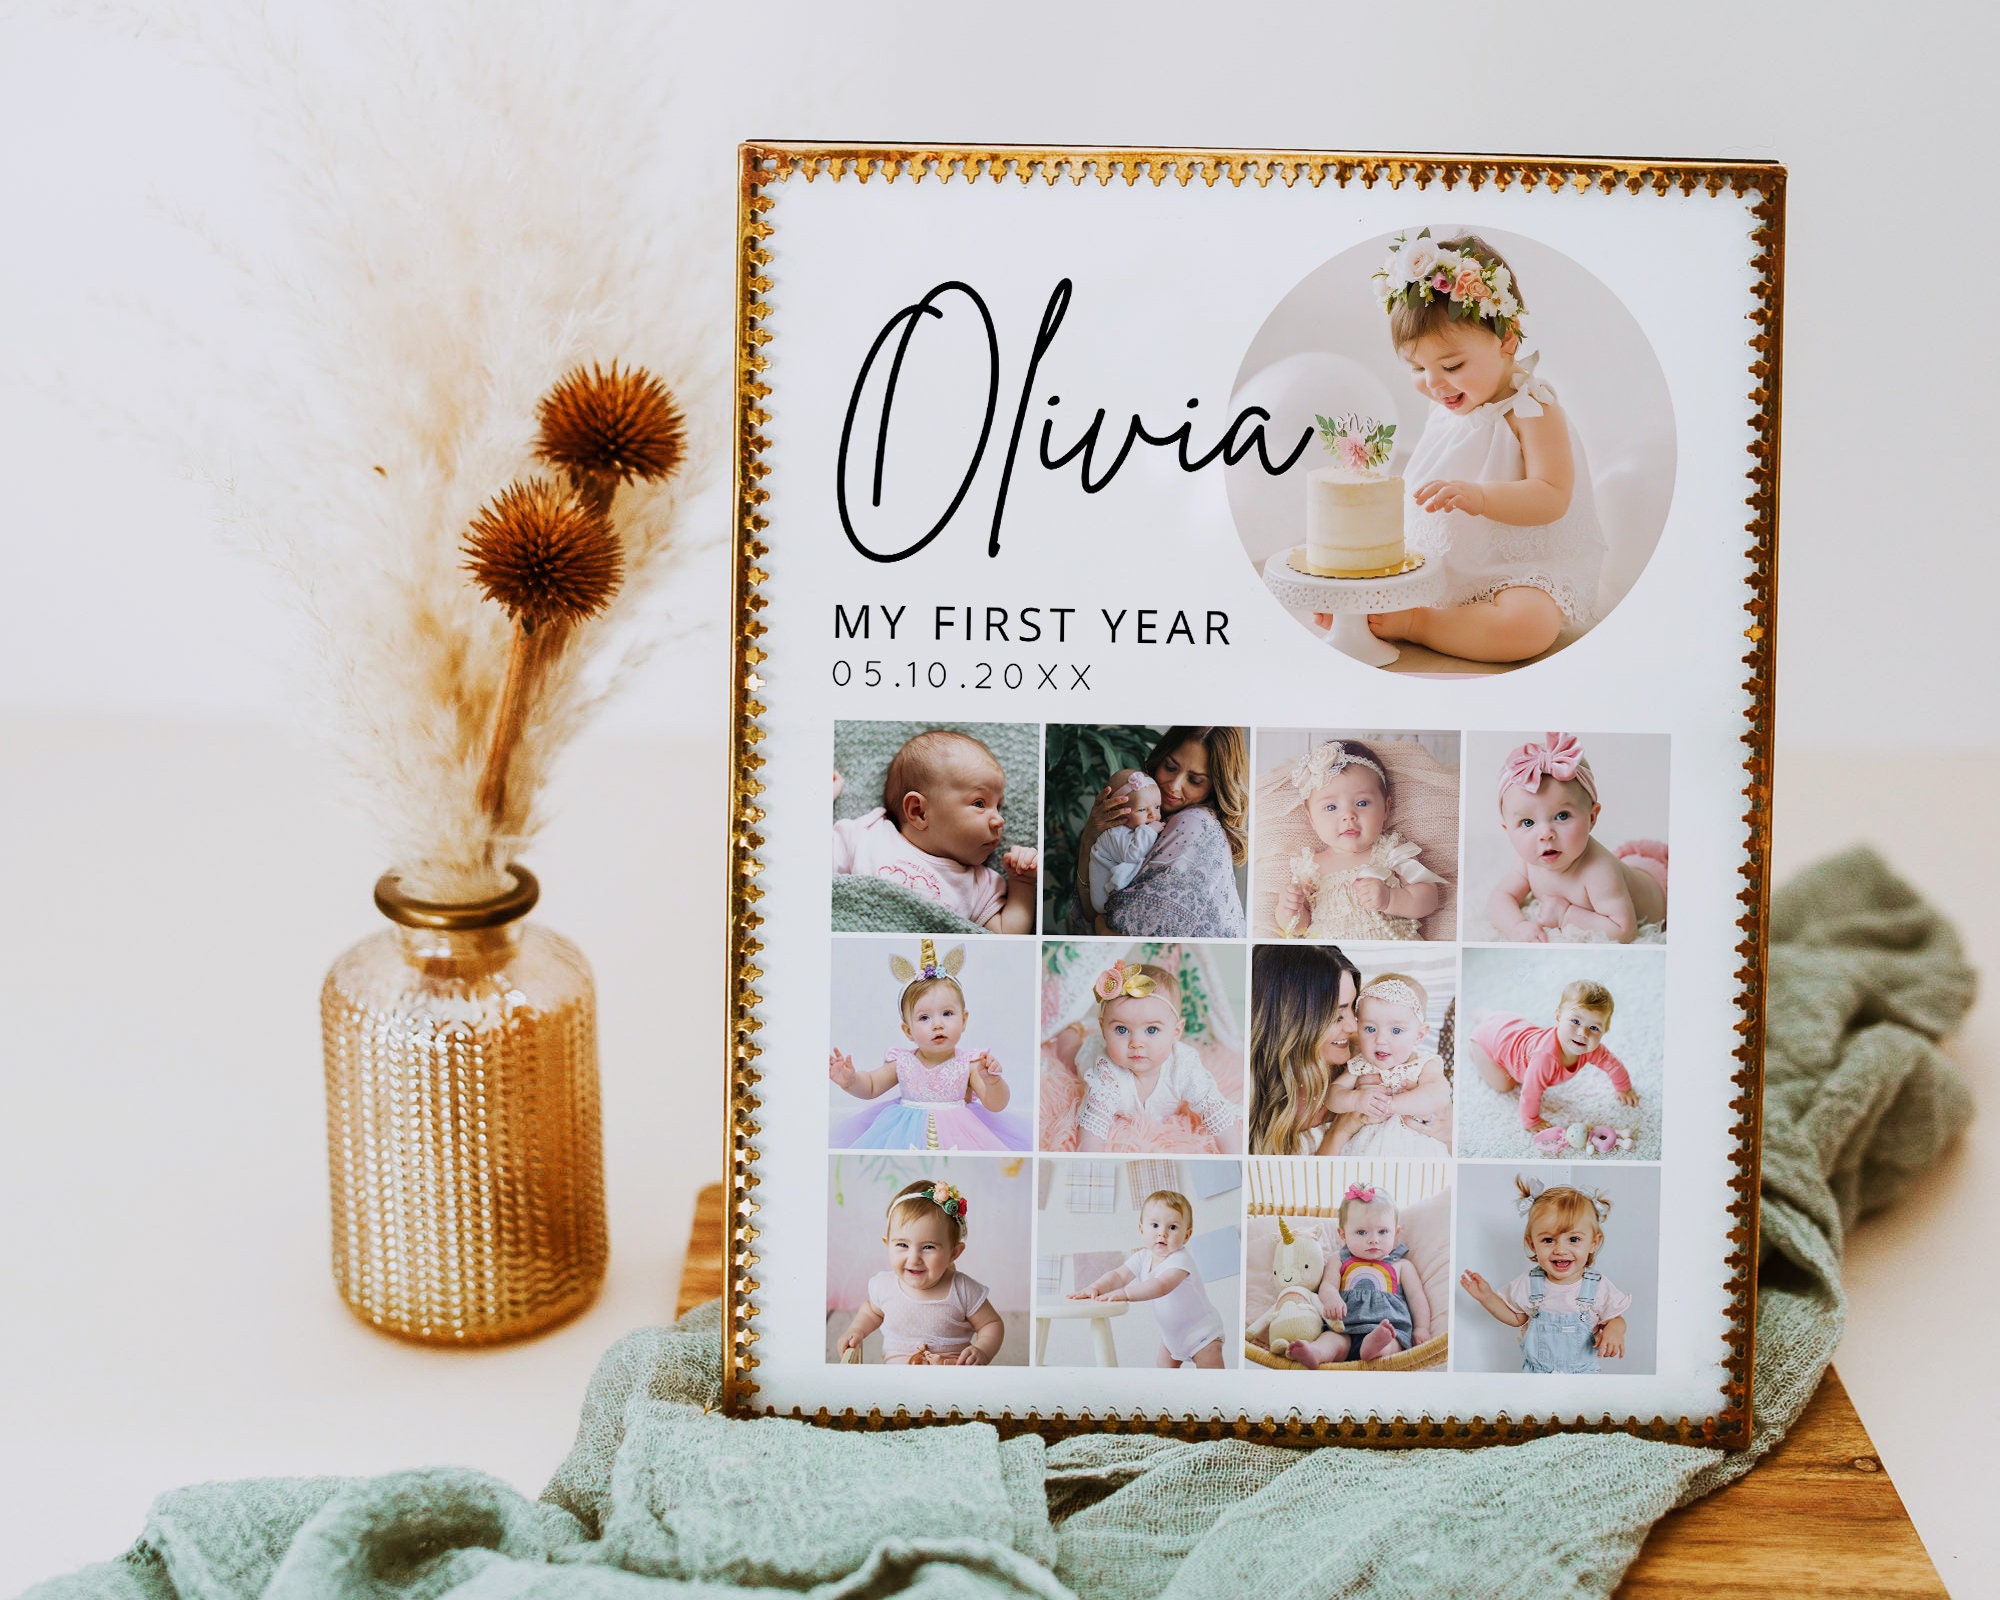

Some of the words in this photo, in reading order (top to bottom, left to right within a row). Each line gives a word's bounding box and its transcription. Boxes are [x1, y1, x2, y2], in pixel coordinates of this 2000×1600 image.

[836, 277, 1315, 563] Olivia
[834, 604, 907, 640] MY
[935, 606, 1076, 643] FIRST
[1101, 608, 1231, 646] YEAR
[832, 660, 1092, 691] 05.10.20XX
